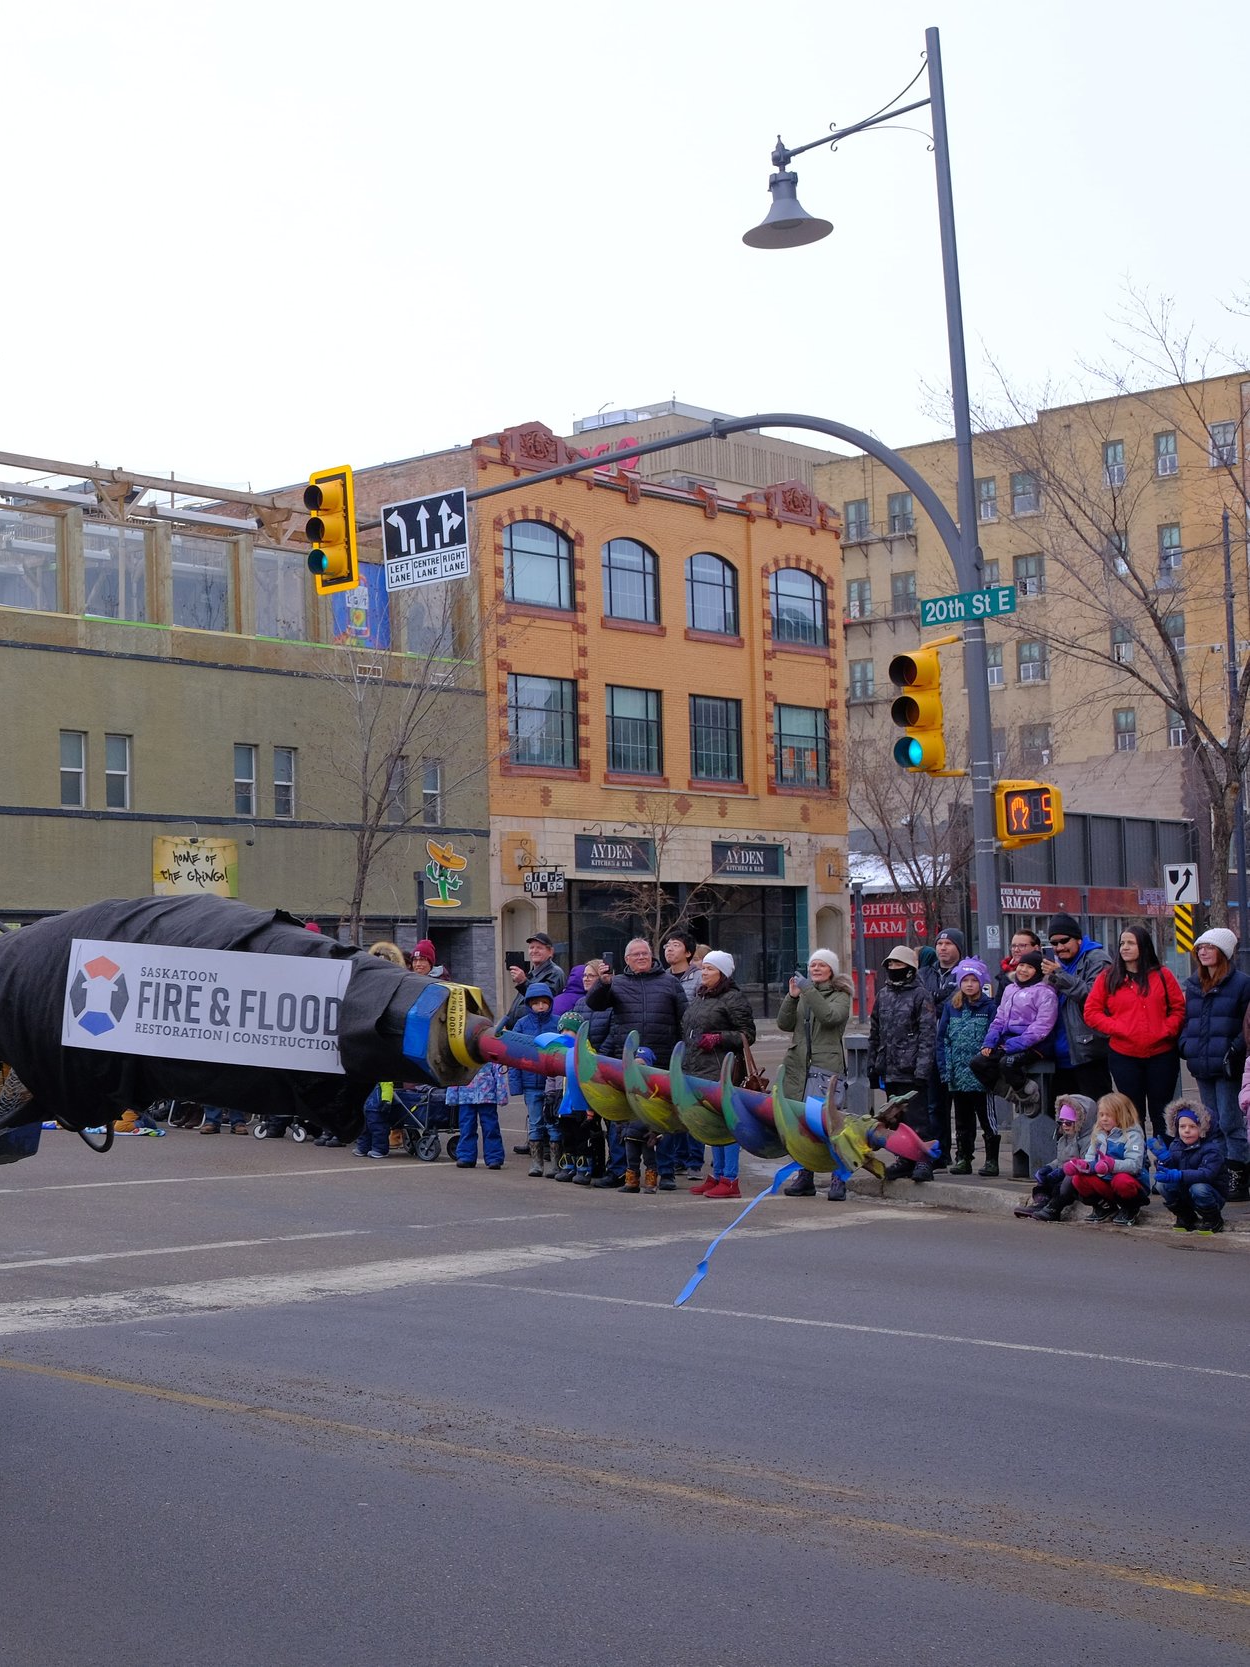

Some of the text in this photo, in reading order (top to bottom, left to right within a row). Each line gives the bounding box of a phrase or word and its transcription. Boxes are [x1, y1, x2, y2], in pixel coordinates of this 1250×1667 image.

[413, 556, 440, 569] CENTRE
[442, 550, 465, 563] RIGHT
[390, 562, 409, 574] LEFT
[416, 567, 438, 578] LANE
[444, 561, 465, 573] LANE
[390, 572, 411, 584] LANE
[925, 590, 1010, 622] 20th St E
[1041, 794, 1054, 824] 5
[590, 844, 633, 859] AYDEN
[725, 850, 764, 865] AYDEN
[591, 859, 615, 867] KITCHEN
[525, 872, 554, 882] cfcr
[525, 882, 555, 892] 90.5
[140, 966, 218, 983] SASKATOON
[137, 980, 343, 1037] FIRE & FLOOD
[135, 1022, 223, 1041] RESTORATION
[232, 1032, 339, 1051] CONSTRUCTION
